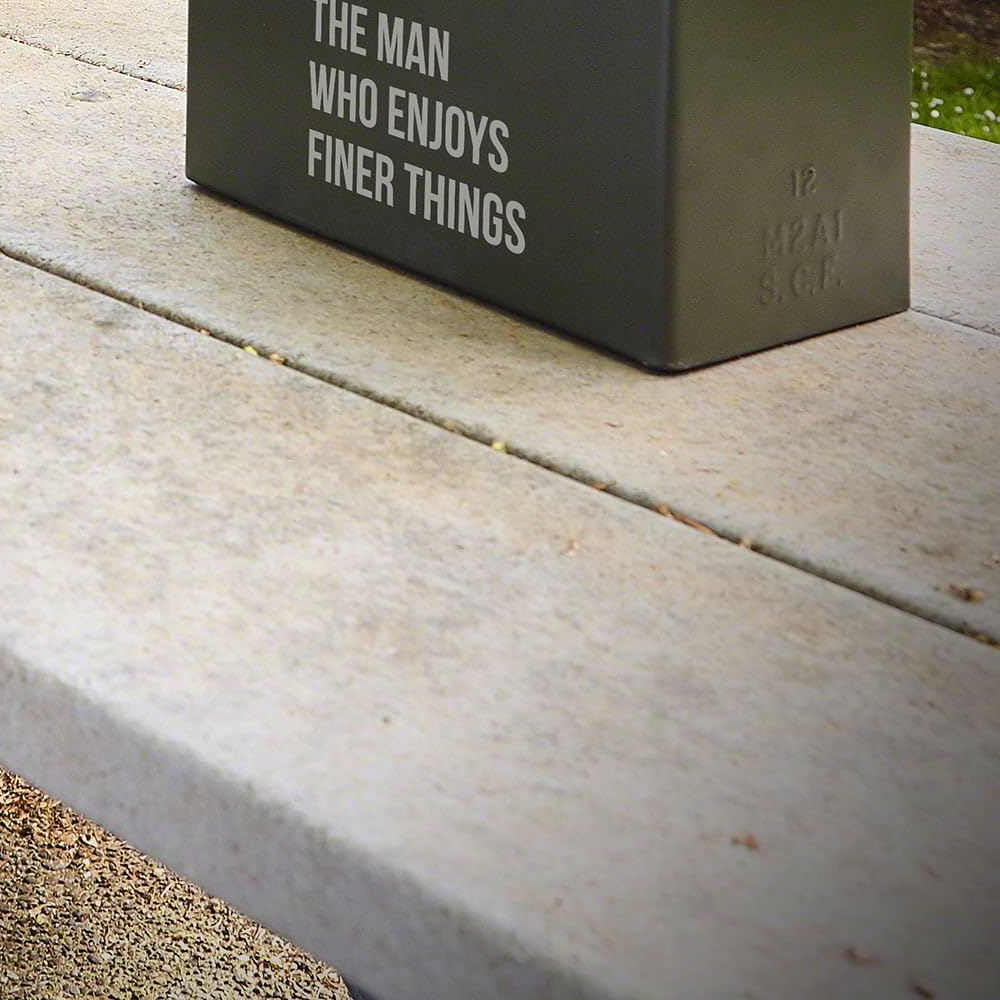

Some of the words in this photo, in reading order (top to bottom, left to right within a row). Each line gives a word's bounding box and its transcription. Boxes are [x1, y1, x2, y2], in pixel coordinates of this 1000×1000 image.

[377, 12, 450, 82] MAN
[309, 60, 378, 129] WHO
[388, 85, 509, 173] ENJOYS
[308, 128, 394, 208] FINER
[403, 162, 526, 255] THINGS
[790, 163, 818, 198] 12
